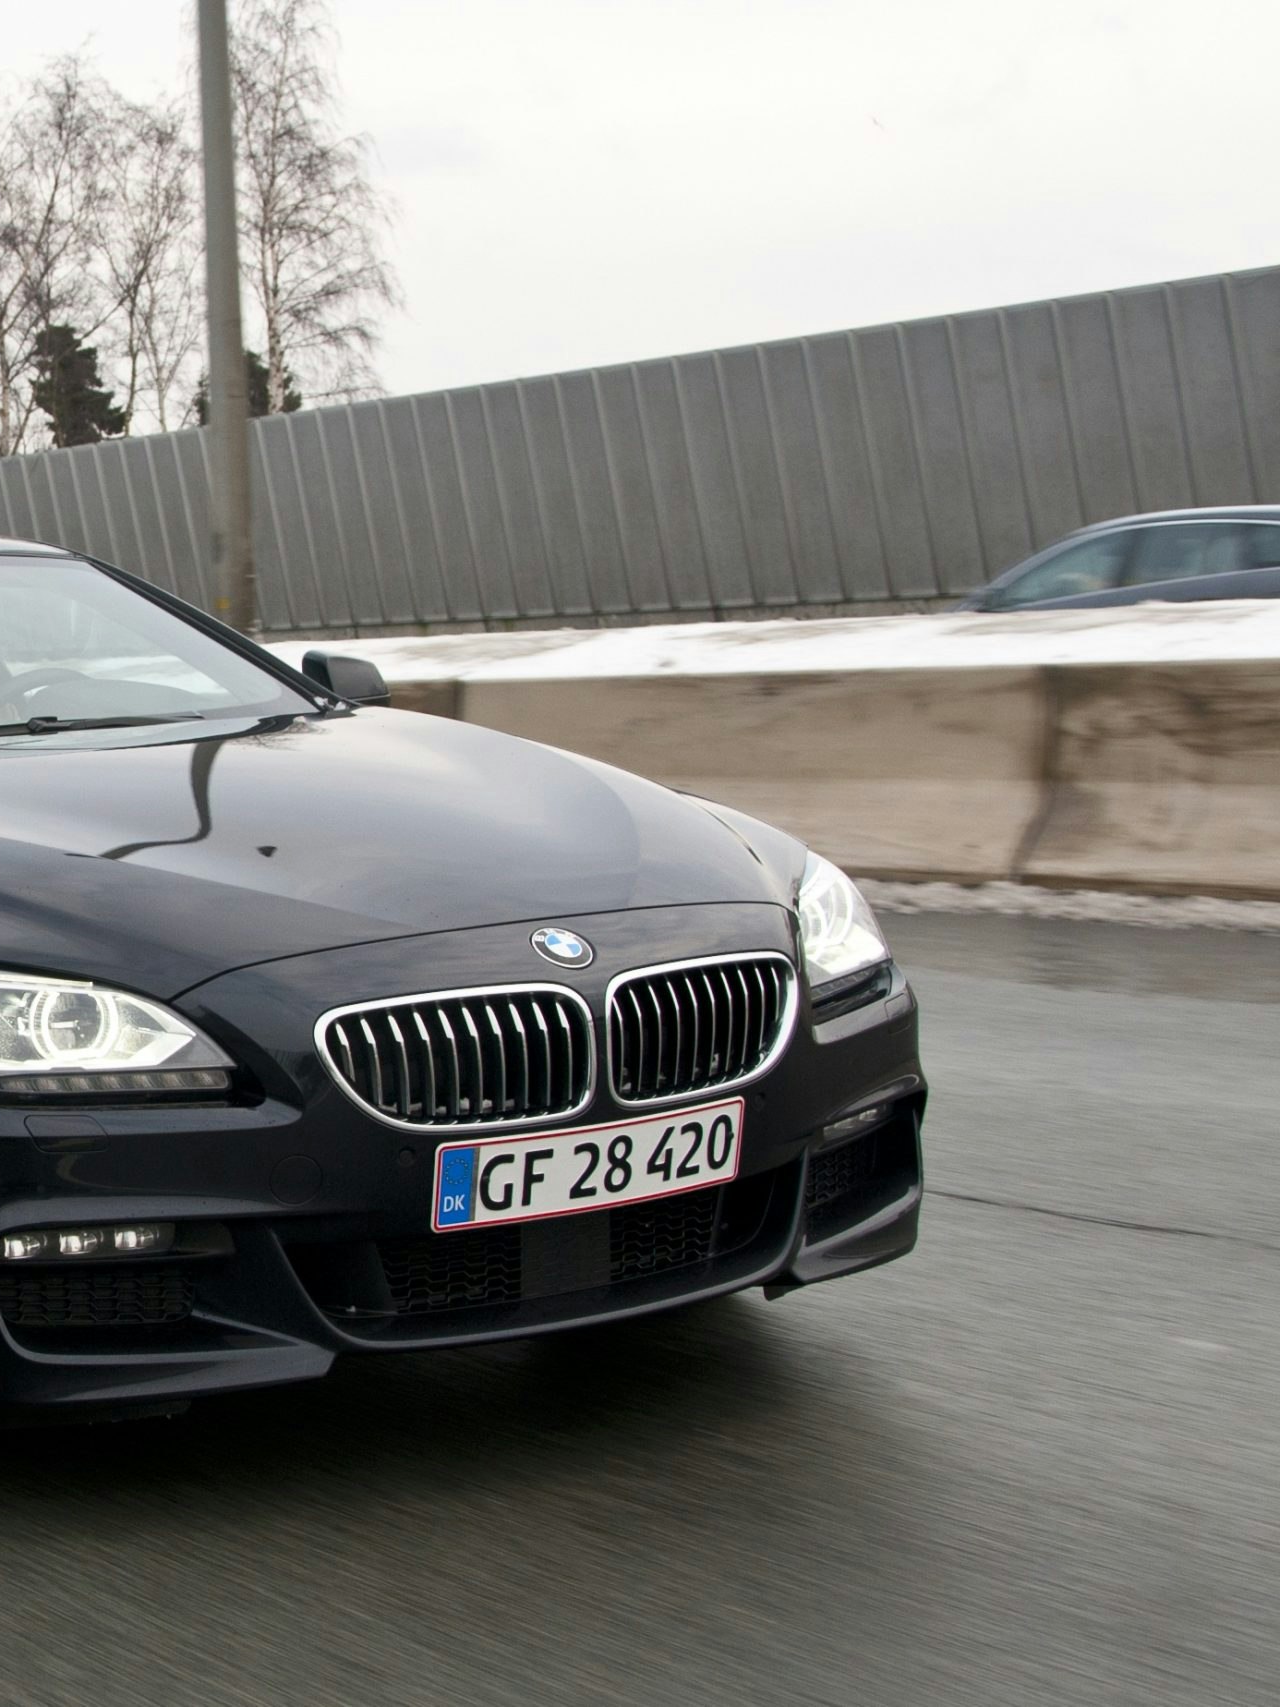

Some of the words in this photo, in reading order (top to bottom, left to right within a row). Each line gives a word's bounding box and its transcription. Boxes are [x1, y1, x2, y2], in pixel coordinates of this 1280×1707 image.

[479, 1148, 554, 1212] GF
[569, 1134, 633, 1200] 28
[646, 1113, 735, 1182] 420
[443, 1194, 465, 1213] DK
